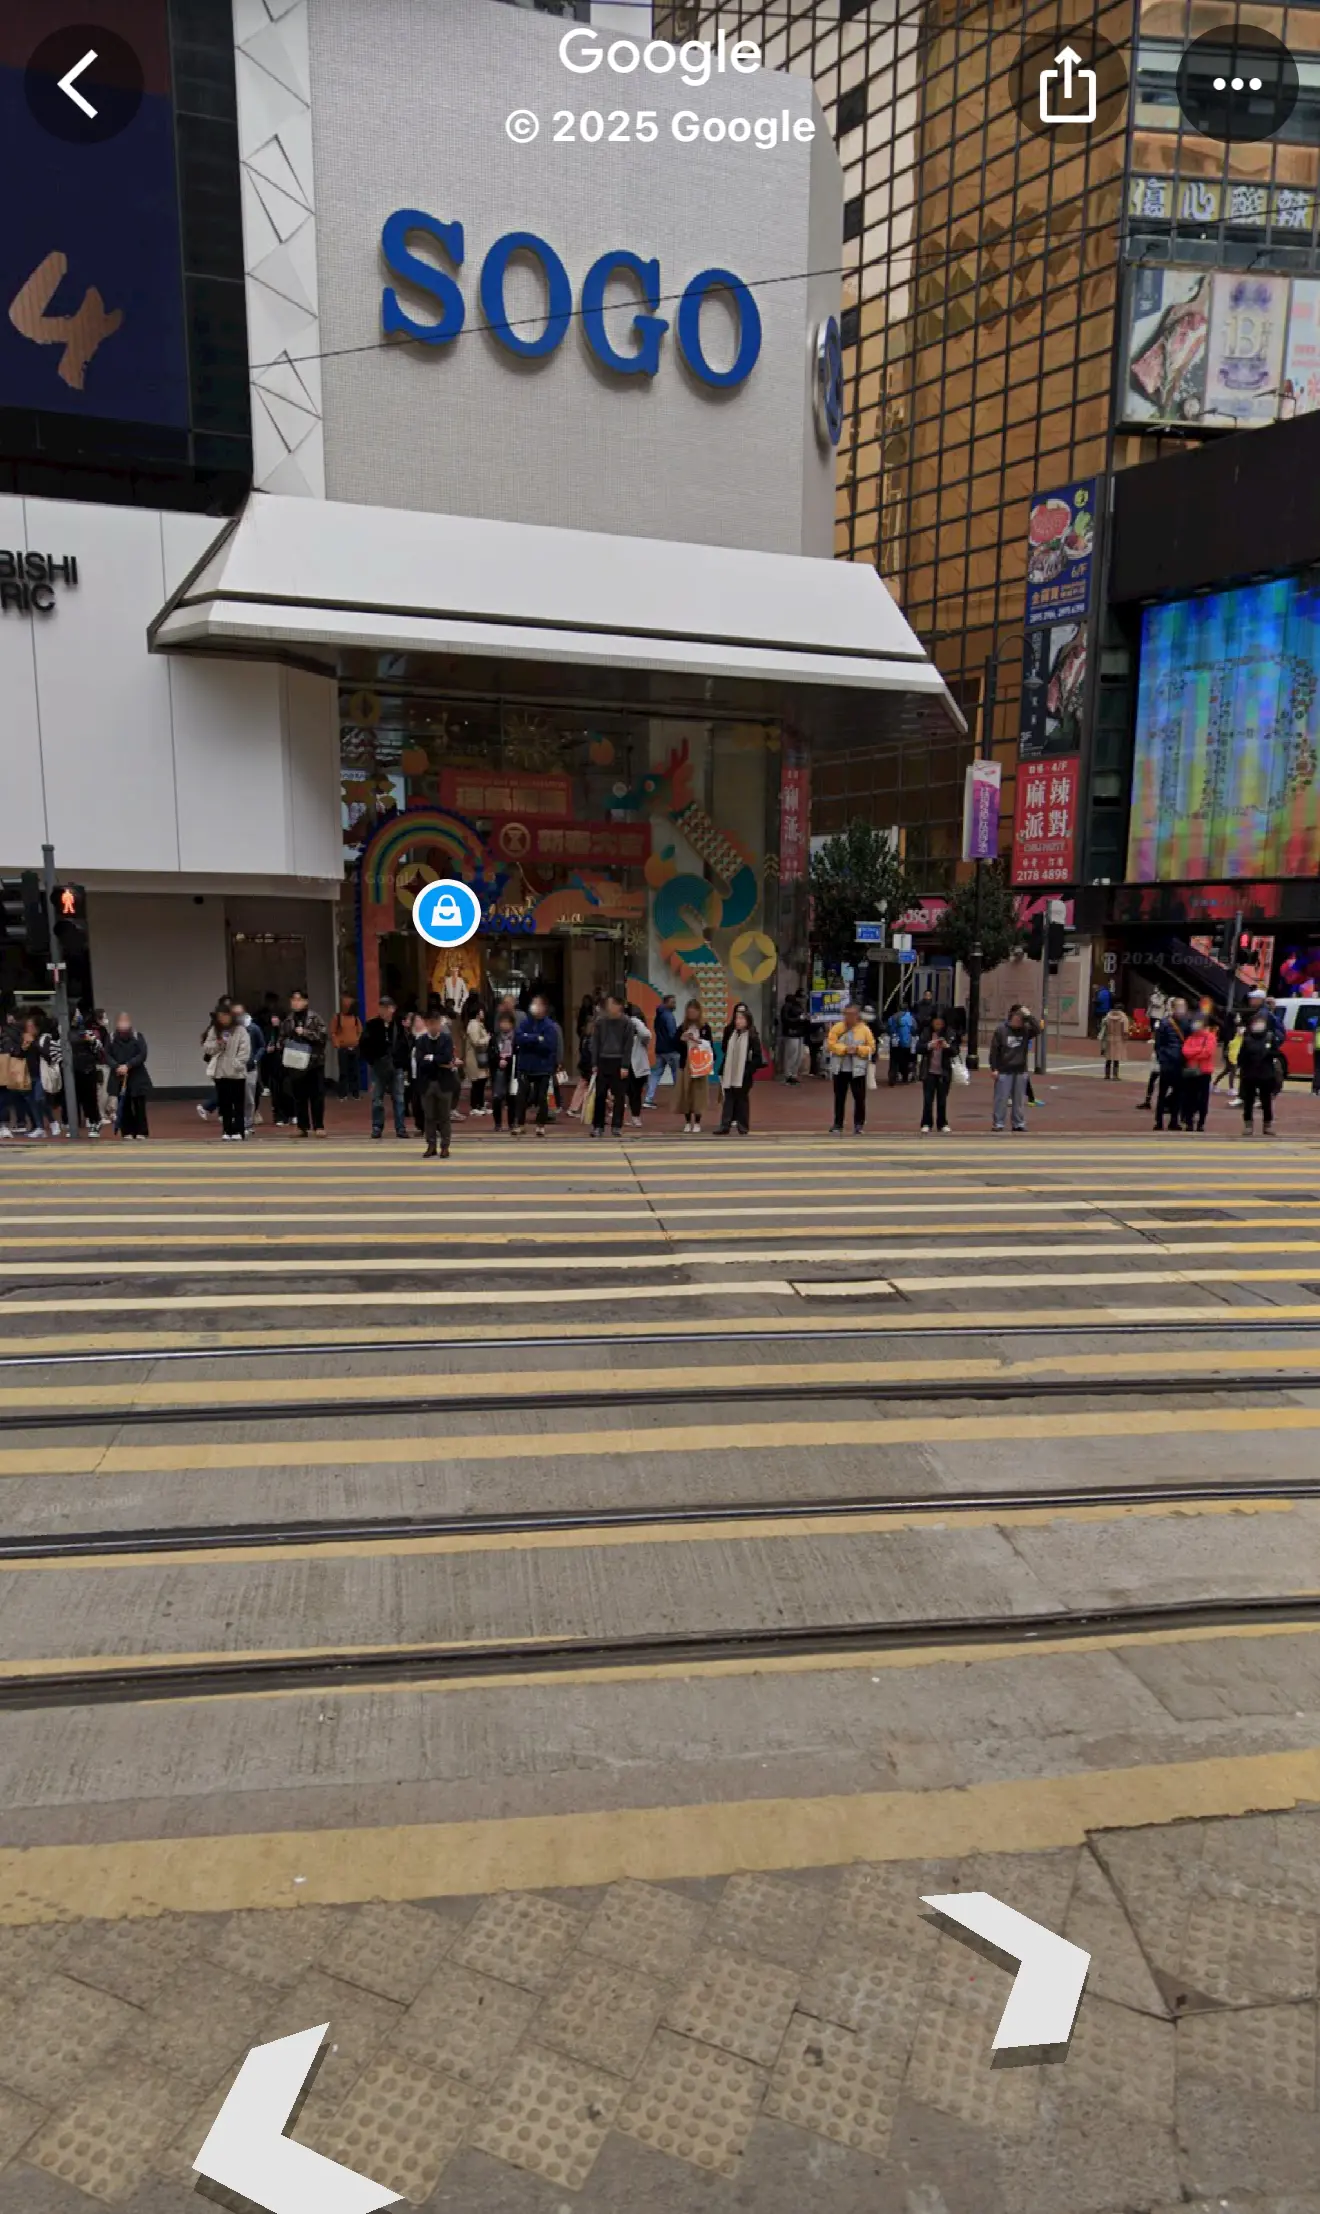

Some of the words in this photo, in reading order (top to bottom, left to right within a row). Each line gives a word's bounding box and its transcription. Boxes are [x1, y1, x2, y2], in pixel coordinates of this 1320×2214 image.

[382, 208, 762, 388] SOGO
[1025, 776, 1070, 809] 麻辣
[1024, 809, 1069, 840] 派對
[1016, 870, 1040, 882] 2178
[1041, 868, 1069, 881] 4898
